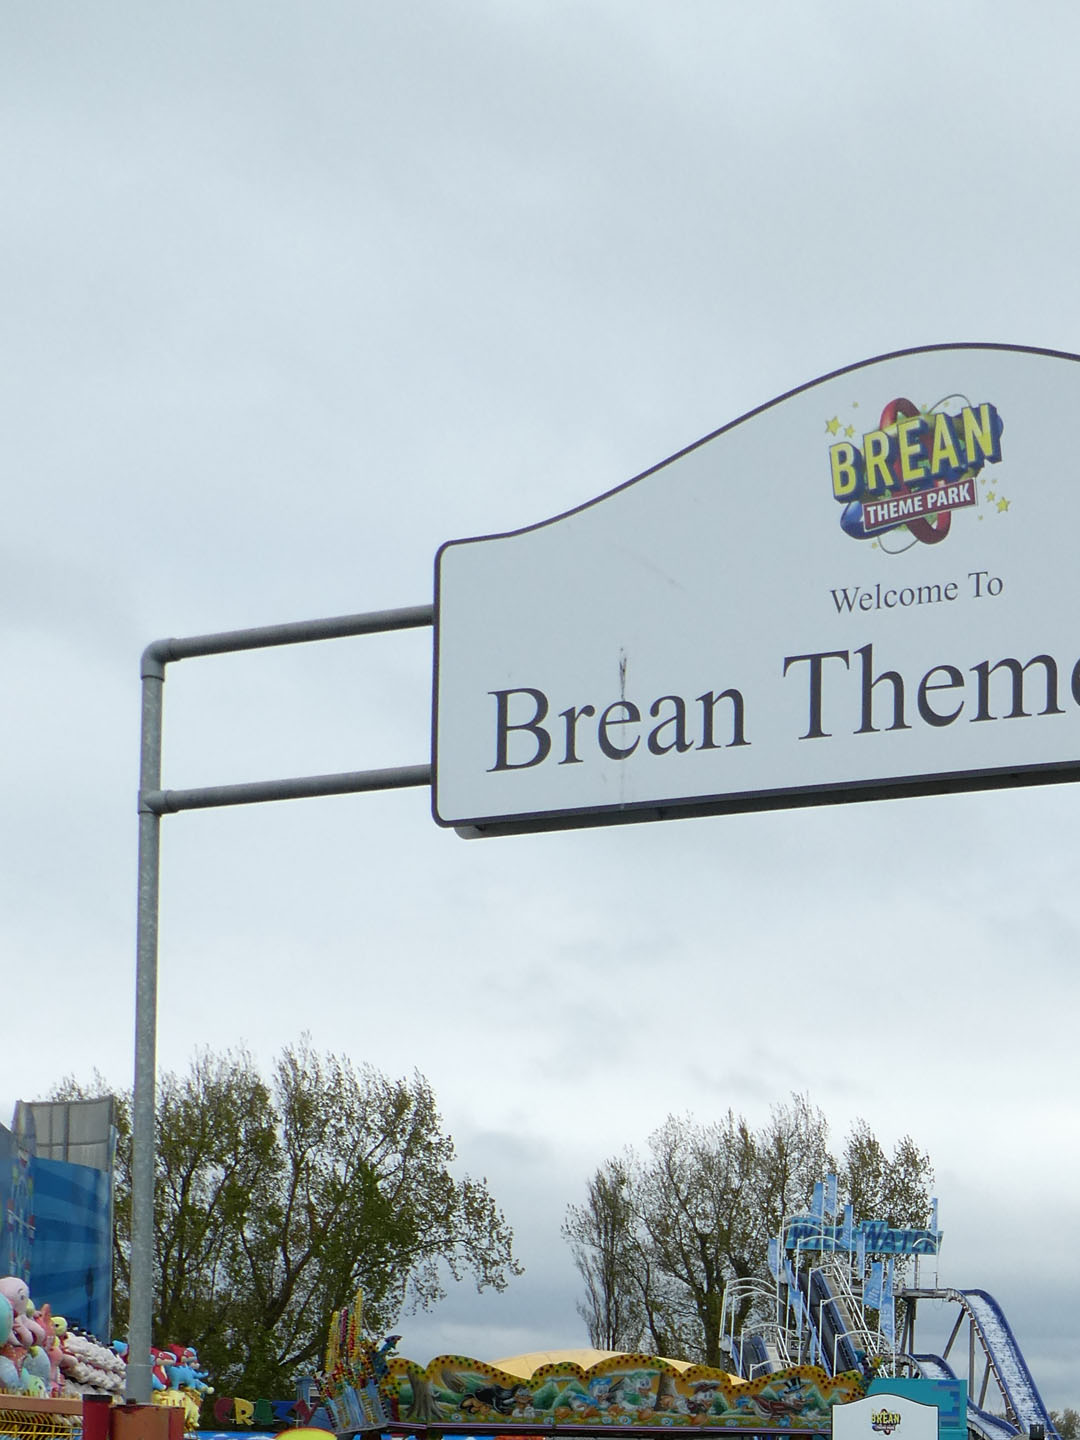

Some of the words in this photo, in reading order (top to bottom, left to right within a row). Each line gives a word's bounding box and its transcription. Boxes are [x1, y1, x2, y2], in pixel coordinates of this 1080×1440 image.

[829, 403, 1000, 500] BREAN
[867, 500, 923, 524] THEME
[927, 483, 971, 509] PARK
[830, 584, 958, 614] Welcome
[968, 571, 1003, 598] To
[486, 687, 752, 773] Brean
[214, 1397, 319, 1426] CRAZY
